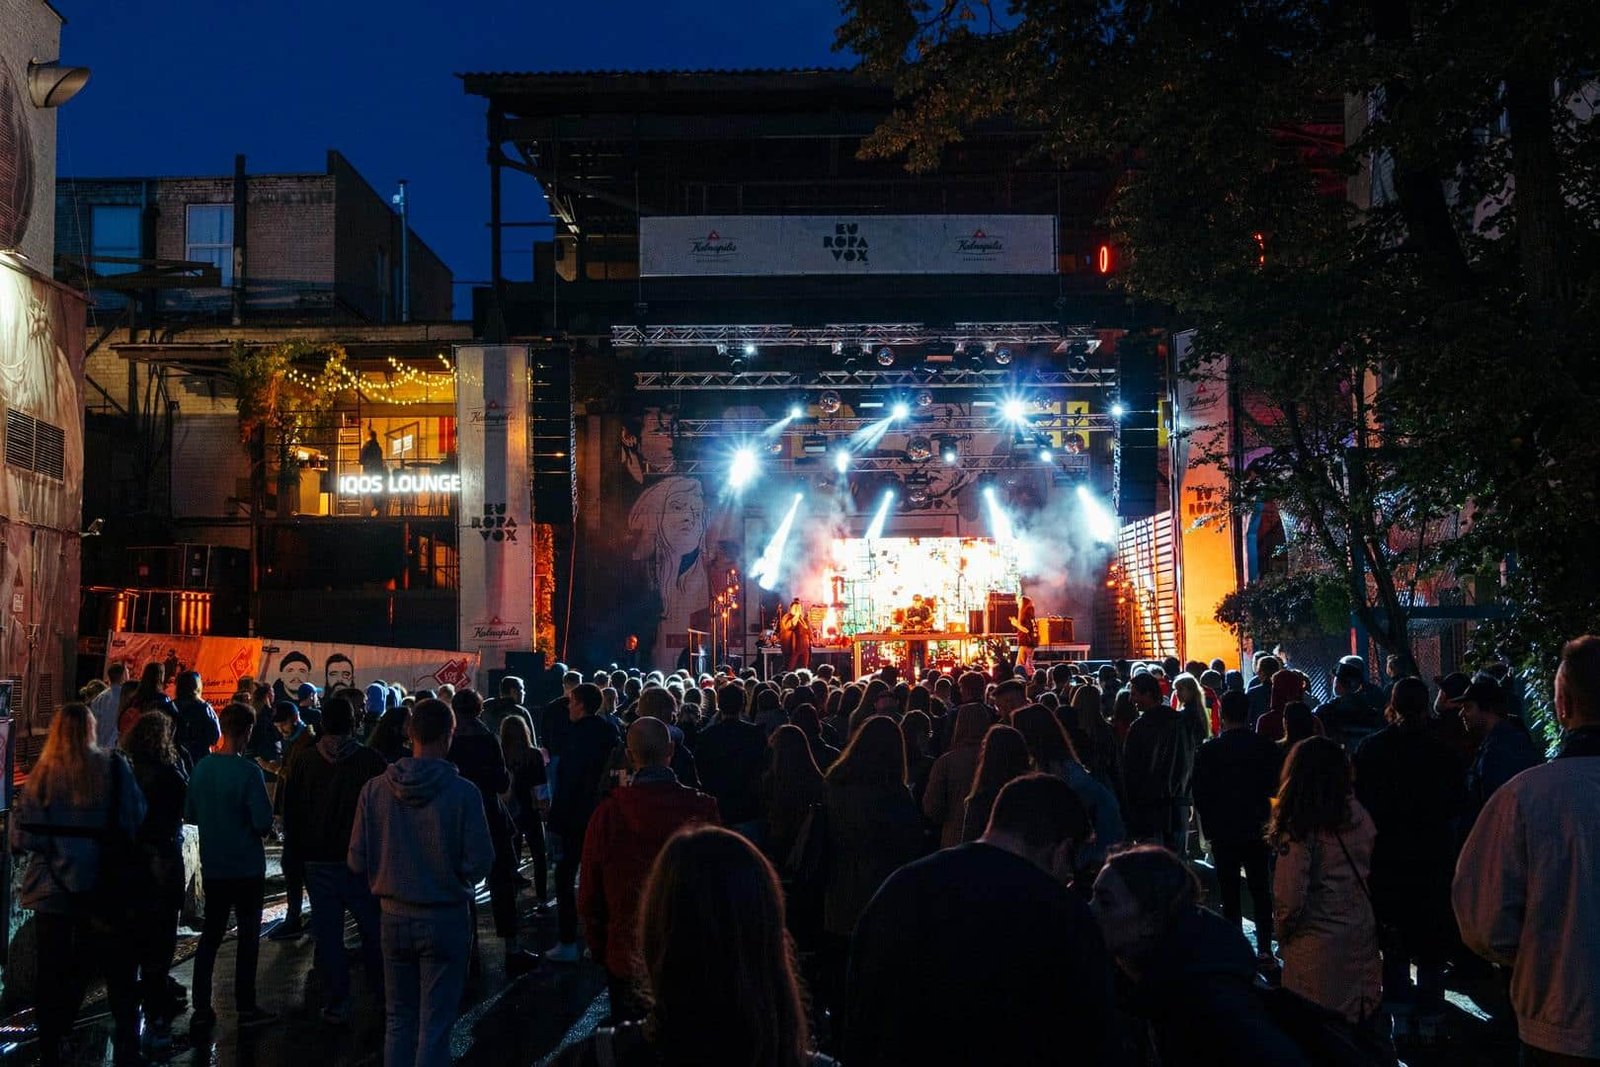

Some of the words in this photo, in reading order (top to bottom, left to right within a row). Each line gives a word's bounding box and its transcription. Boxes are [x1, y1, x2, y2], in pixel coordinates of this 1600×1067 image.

[836, 223, 858, 235] EU
[823, 236, 869, 248] ROPA
[832, 249, 869, 262] VOX
[339, 475, 383, 494] IQOS
[389, 473, 461, 493] LOUNGE
[484, 502, 506, 516] EU
[471, 516, 517, 528] ROPA
[479, 529, 517, 542] VOX
[473, 626, 519, 639] Kalnapilis
